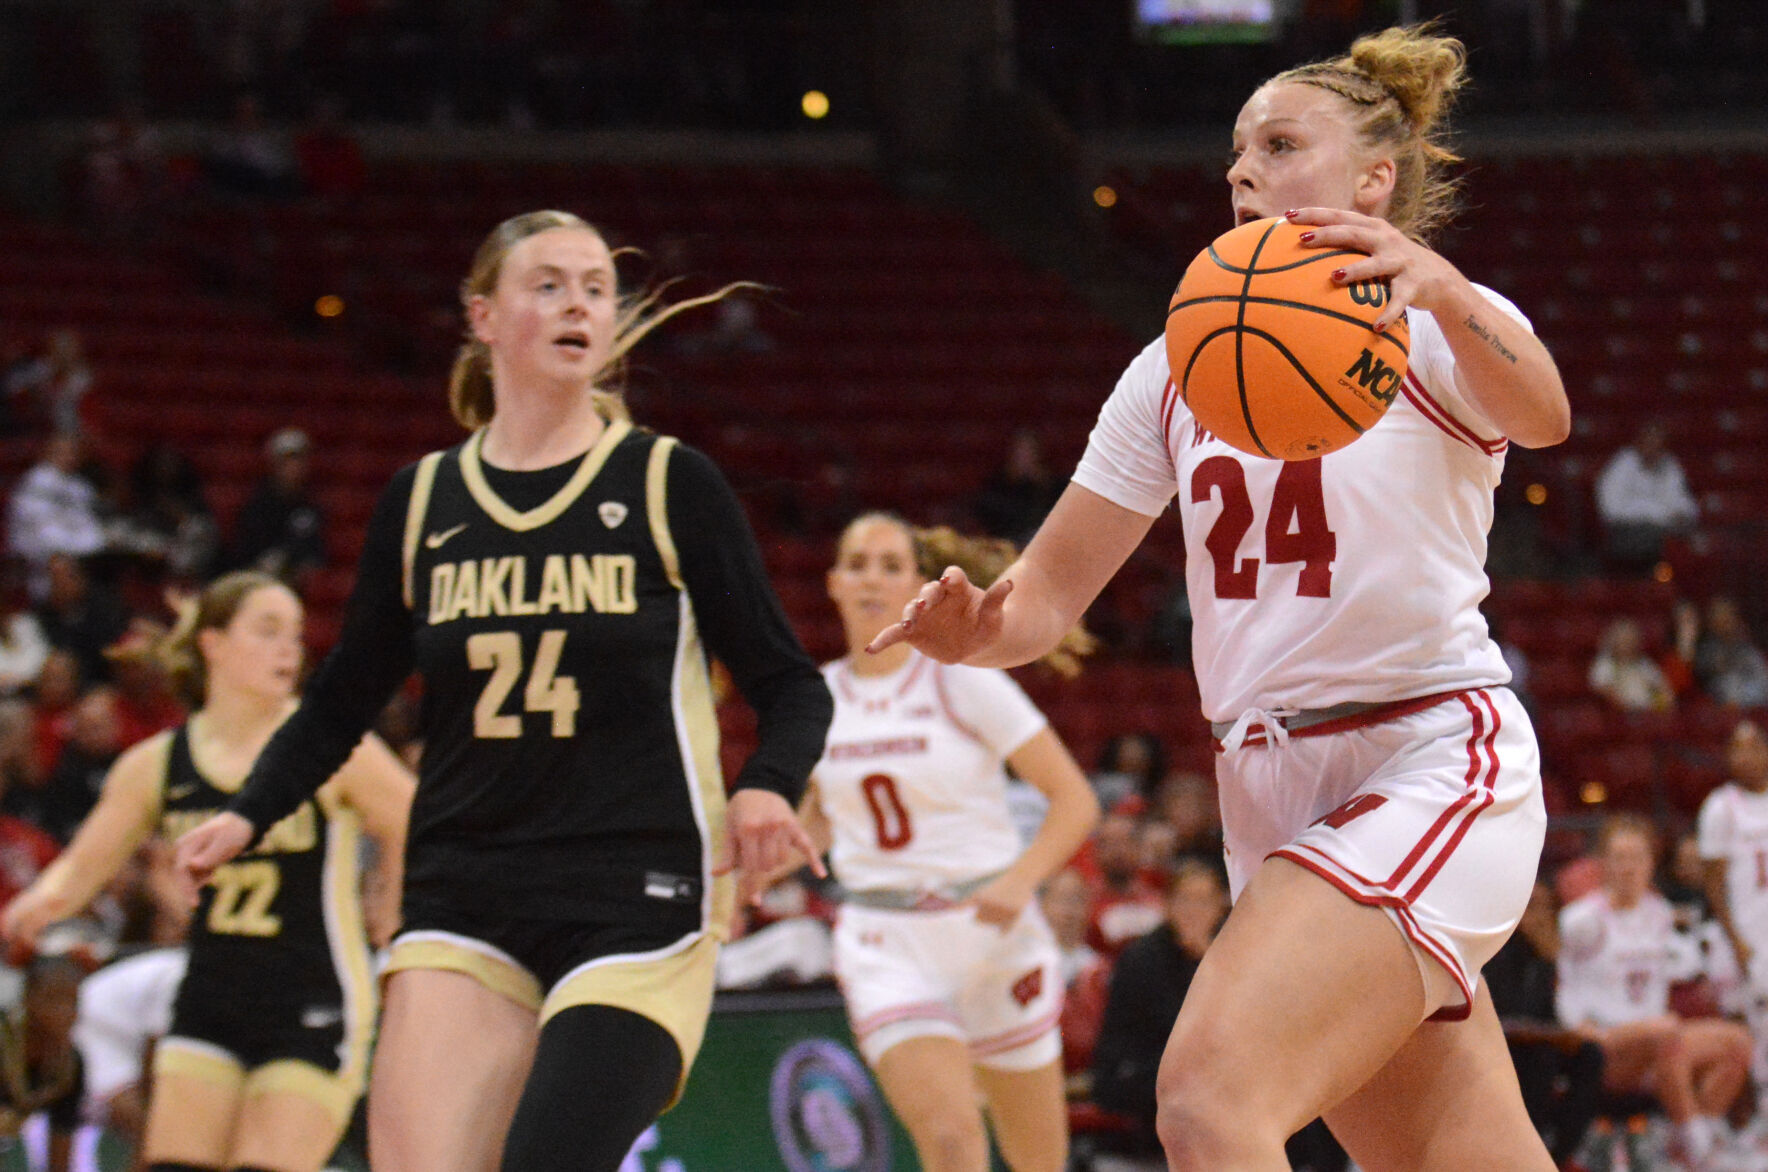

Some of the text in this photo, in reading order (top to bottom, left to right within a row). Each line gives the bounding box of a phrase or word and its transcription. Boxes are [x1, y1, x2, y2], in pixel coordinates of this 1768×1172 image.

[1345, 347, 1401, 407] NCA
[1192, 455, 1337, 600] 24
[428, 554, 638, 626] OAKLAND
[466, 629, 581, 740] 24
[861, 772, 913, 852] 0
[206, 859, 283, 938] 22
